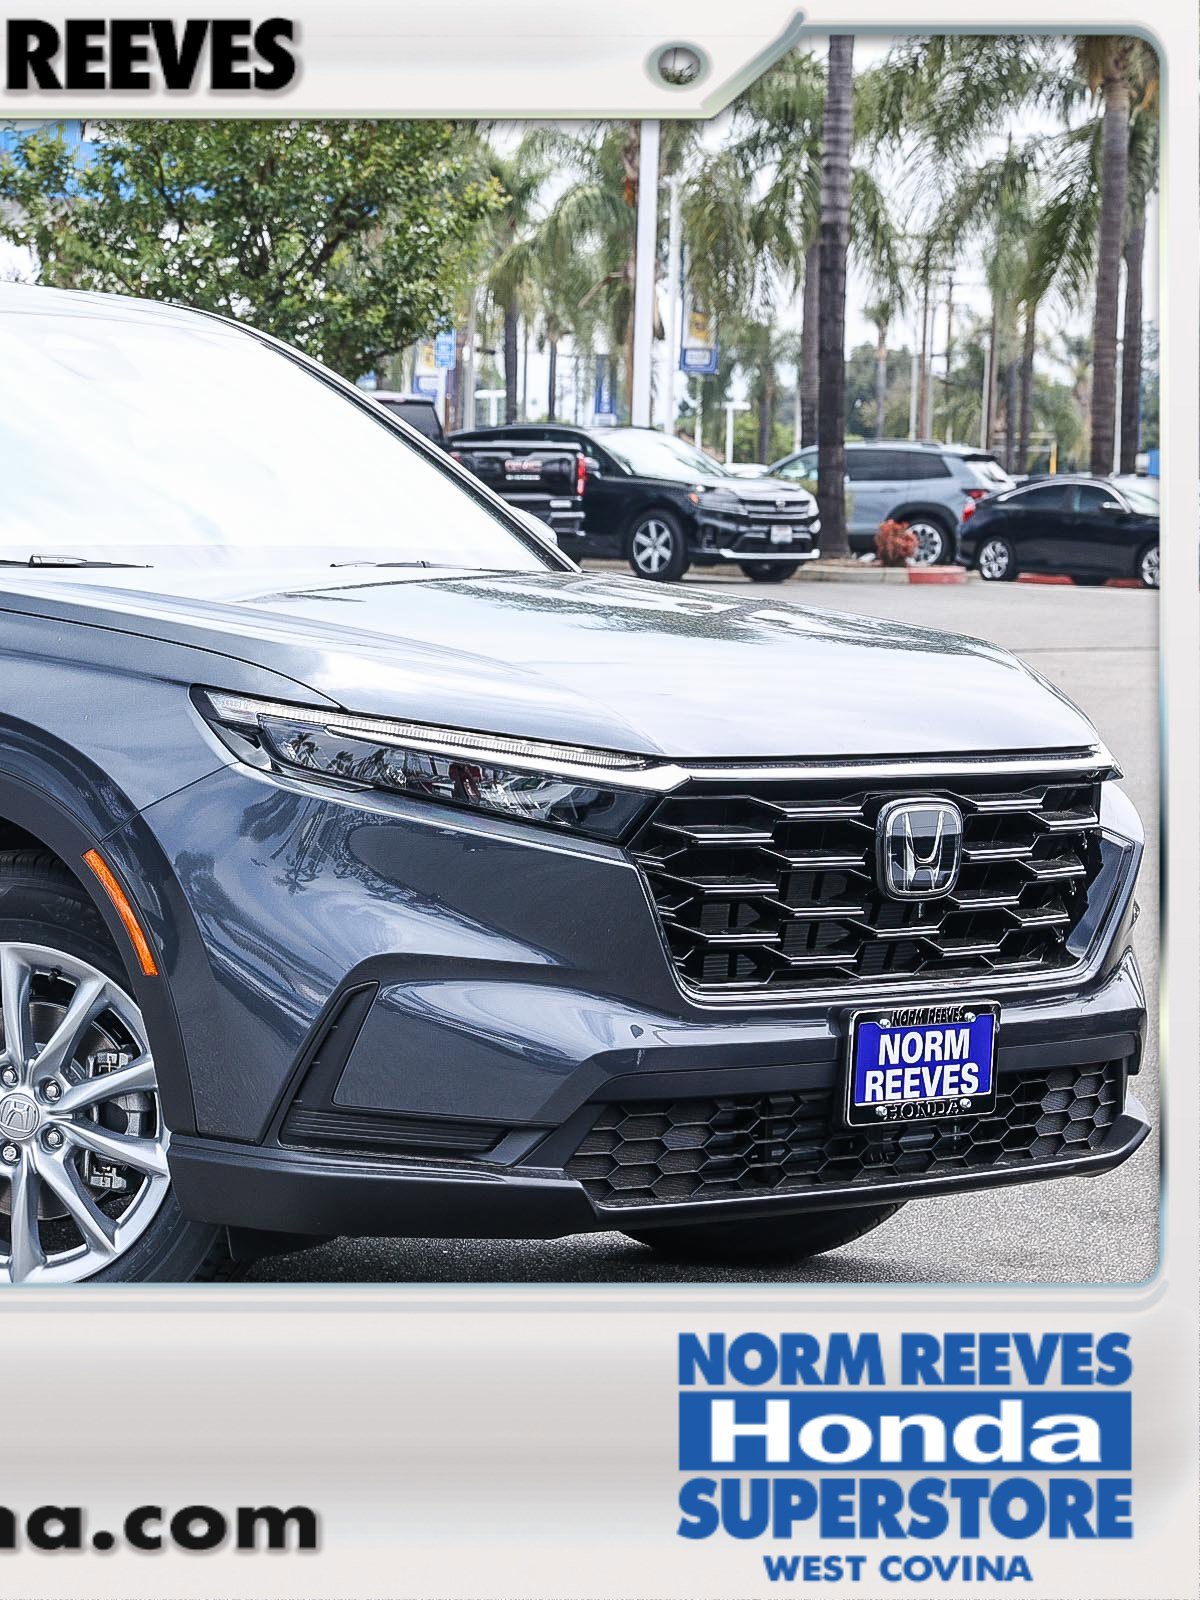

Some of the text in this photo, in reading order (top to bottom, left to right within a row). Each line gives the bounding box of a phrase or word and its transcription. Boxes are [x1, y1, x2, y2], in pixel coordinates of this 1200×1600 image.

[892, 1008, 926, 1027] NORM
[878, 1028, 970, 1066] NORM
[864, 1062, 979, 1102] REEVES
[883, 1098, 961, 1120] HONDA
